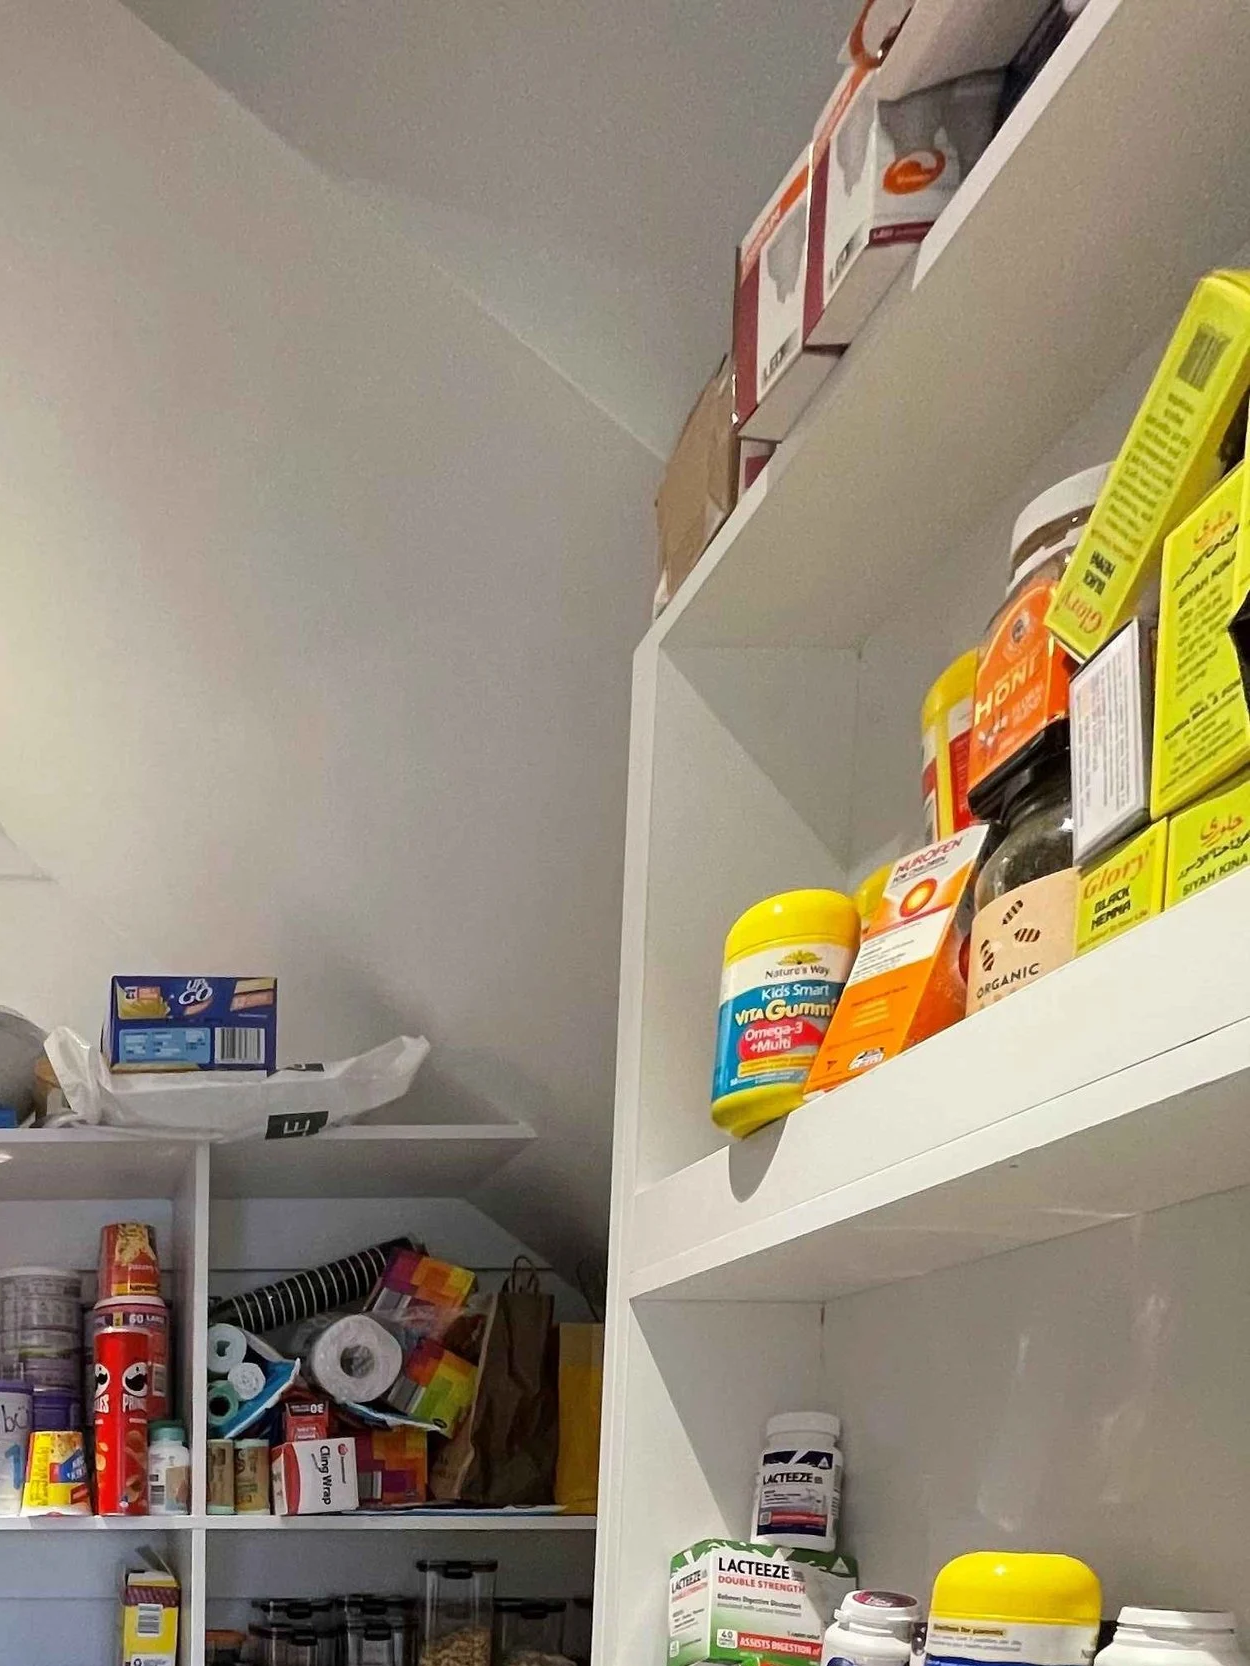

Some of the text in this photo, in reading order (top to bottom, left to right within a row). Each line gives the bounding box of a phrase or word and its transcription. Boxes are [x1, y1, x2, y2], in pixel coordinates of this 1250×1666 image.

[896, 836, 963, 876] NUROFEN
[1084, 855, 1145, 900] Glory
[1091, 899, 1131, 931] HENNA
[765, 964, 831, 980] Nature's Way
[976, 961, 1041, 1000] ORGANIC
[761, 983, 830, 1001] Kids Smart
[734, 999, 837, 1026] VITA Gummi
[744, 1021, 803, 1042] Omega-3
[749, 1037, 792, 1053] +Multi
[318, 1445, 334, 1506] Cling Wrap
[762, 1472, 813, 1486] LACTEEZE
[717, 1556, 791, 1580] LACTEEZE
[671, 1569, 702, 1594] LACTEEZE
[717, 1574, 806, 1594] DOUBLE STRENGTH
[739, 1634, 770, 1649] ASSISTS
[771, 1638, 812, 1655] DIGESTION
